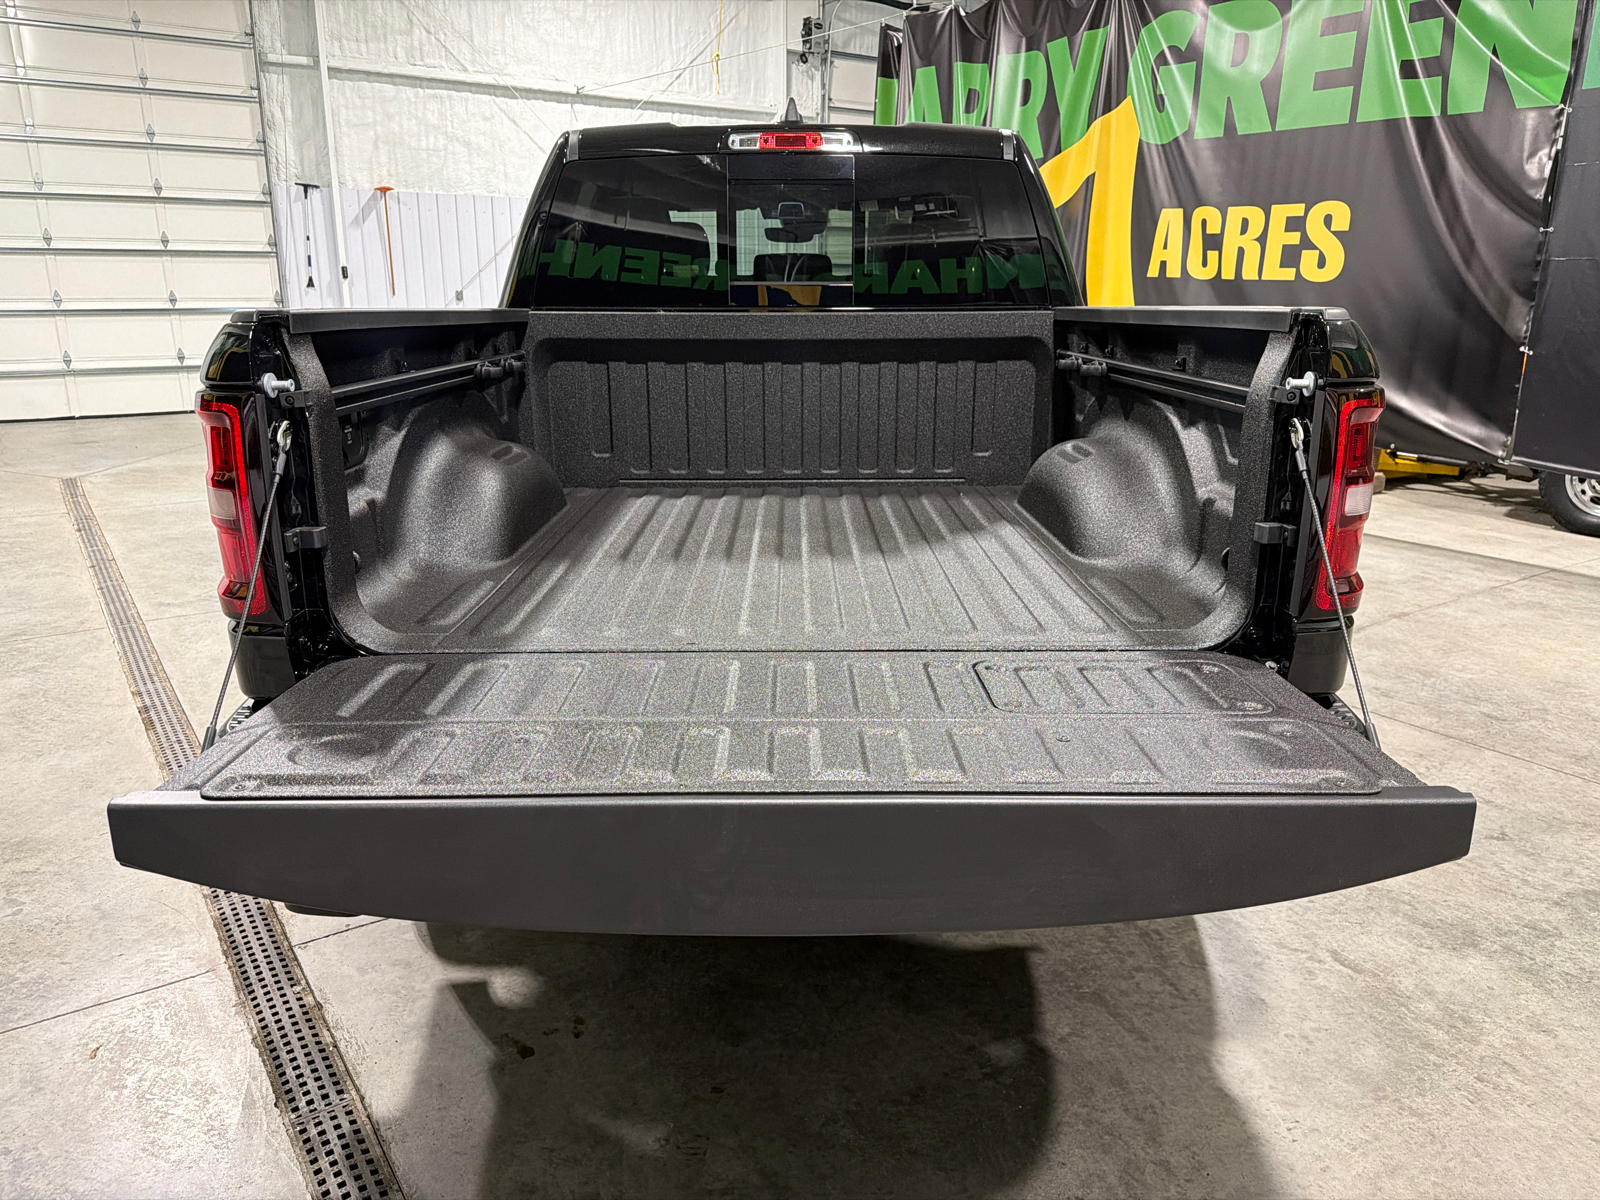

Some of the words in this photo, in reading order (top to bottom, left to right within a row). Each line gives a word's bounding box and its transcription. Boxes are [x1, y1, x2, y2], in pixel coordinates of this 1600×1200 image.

[875, 25, 1109, 159] ARRY
[1127, 0, 1577, 144] GREEN
[1147, 201, 1351, 283] ACRES
